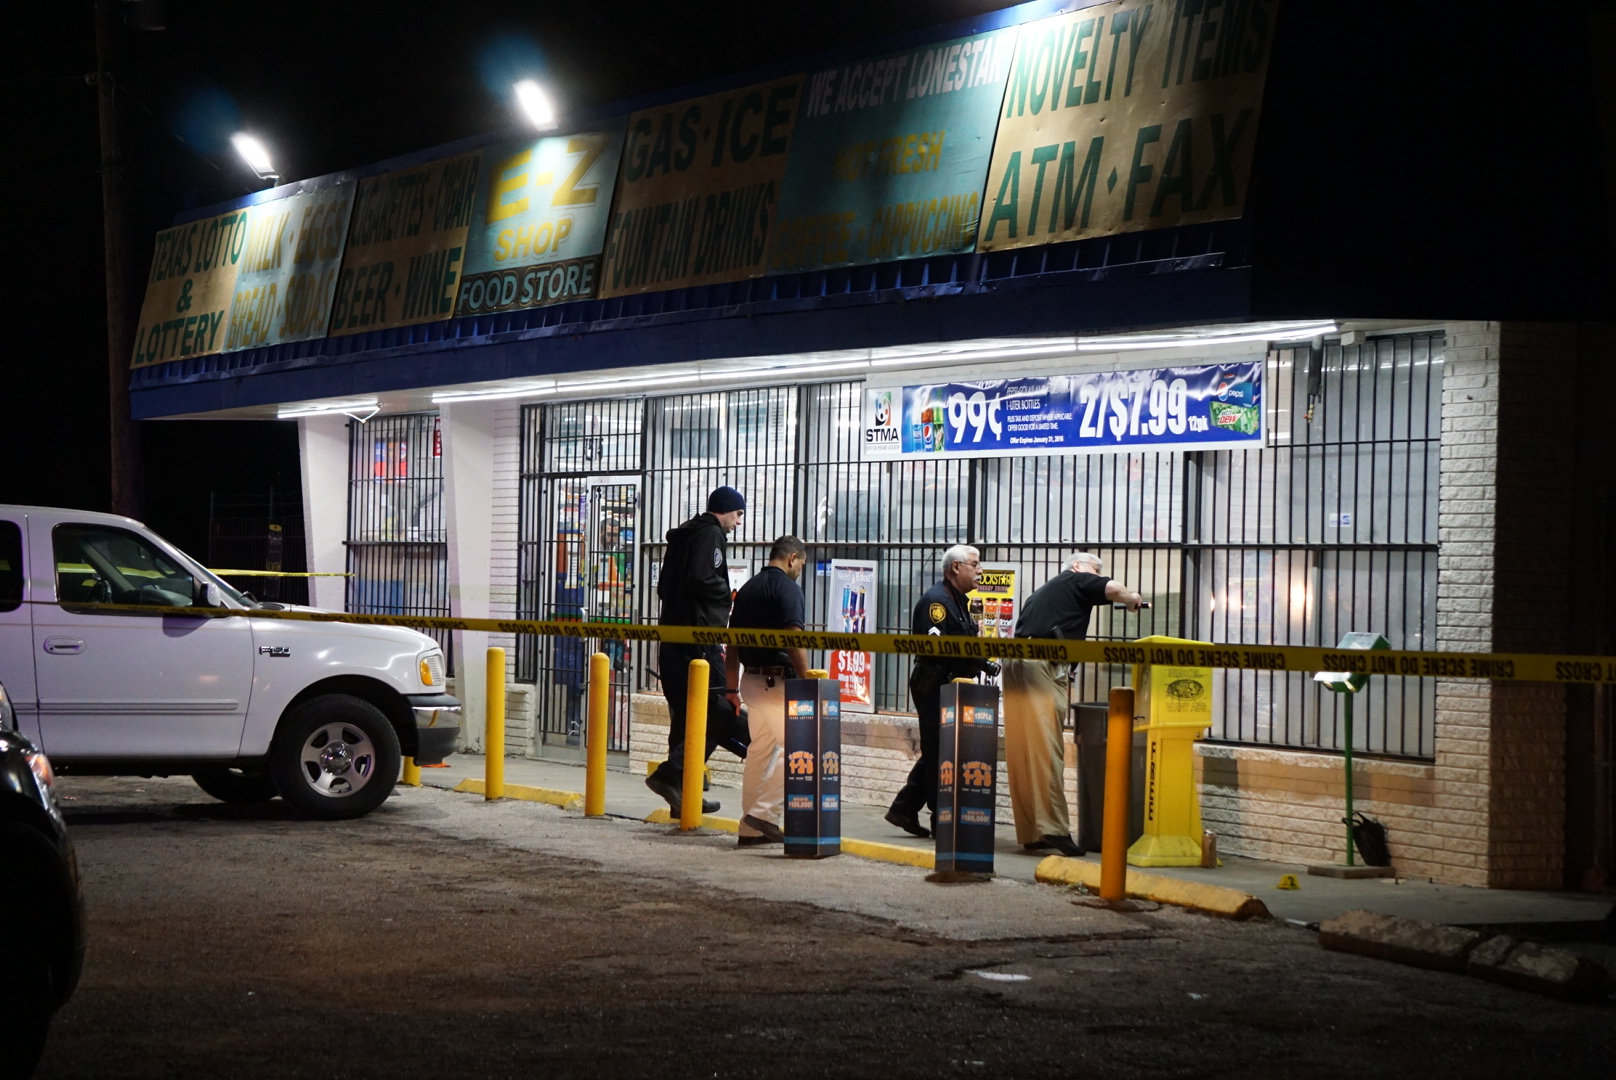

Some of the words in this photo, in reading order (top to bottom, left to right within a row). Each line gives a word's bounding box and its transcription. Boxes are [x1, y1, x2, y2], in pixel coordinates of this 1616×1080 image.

[1006, 5, 1150, 118] NOVELTY
[1162, 0, 1269, 88] ITEMS
[807, 70, 836, 118] WE
[834, 55, 907, 113] ACCEPT
[906, 34, 1006, 99] LONESTAR
[625, 105, 700, 183] GAS
[711, 84, 798, 167] ICE
[876, 130, 945, 176] FRESH
[485, 134, 610, 226] E-Z
[984, 136, 1104, 241] ATM
[1123, 108, 1253, 222] FAX
[242, 211, 290, 274] MILK
[293, 199, 348, 263] EGGS
[602, 197, 699, 291] FOUNTAIN
[694, 180, 775, 276] DRINKS
[773, 212, 855, 269] COFFEE
[869, 192, 978, 258] CAPPUCCINO
[151, 224, 197, 282] TEXAS
[194, 211, 247, 273] LOTTO
[494, 218, 573, 262] SHOP
[176, 279, 193, 312] &
[334, 261, 393, 329] BEER
[402, 247, 462, 319] WINE
[458, 276, 517, 311] FOOD
[522, 263, 594, 300] STORE
[227, 283, 277, 350] BREAD
[279, 268, 335, 338] SODAS
[134, 309, 224, 364] LOTTERY
[1021, 399, 1040, 410] BOTTLES
[1079, 378, 1187, 441] 2/$7.99
[1188, 415, 1209, 432] 12pk
[866, 428, 899, 442] STMA
[498, 622, 536, 634] CROSS
[540, 624, 561, 635] NOT
[564, 626, 580, 636] DO
[582, 627, 619, 638] SCENE
[622, 628, 661, 640] CRIME
[692, 630, 731, 644] CROSS
[734, 632, 758, 645] NOT
[762, 634, 777, 646] DO
[780, 635, 817, 649] SCENE
[820, 636, 860, 650] CRIME
[893, 638, 933, 653] CROSS
[937, 640, 961, 655] NOT
[964, 642, 982, 656] DO
[984, 642, 1024, 658] SCENE
[1027, 644, 1068, 660] CRIME
[1104, 646, 1145, 663] CROSS
[1149, 648, 1174, 665] NOT
[1178, 649, 1195, 665] DO
[1199, 650, 1240, 668] SCENE
[1243, 652, 1285, 669] CRIME
[1323, 654, 1366, 672] CROSS
[1371, 655, 1396, 674] NOT
[1401, 656, 1418, 674] DO
[1423, 658, 1466, 676] SCENE
[1471, 659, 1515, 678] CRIME
[1555, 661, 1599, 681] CROSS
[1288, 876, 1296, 886] 2
